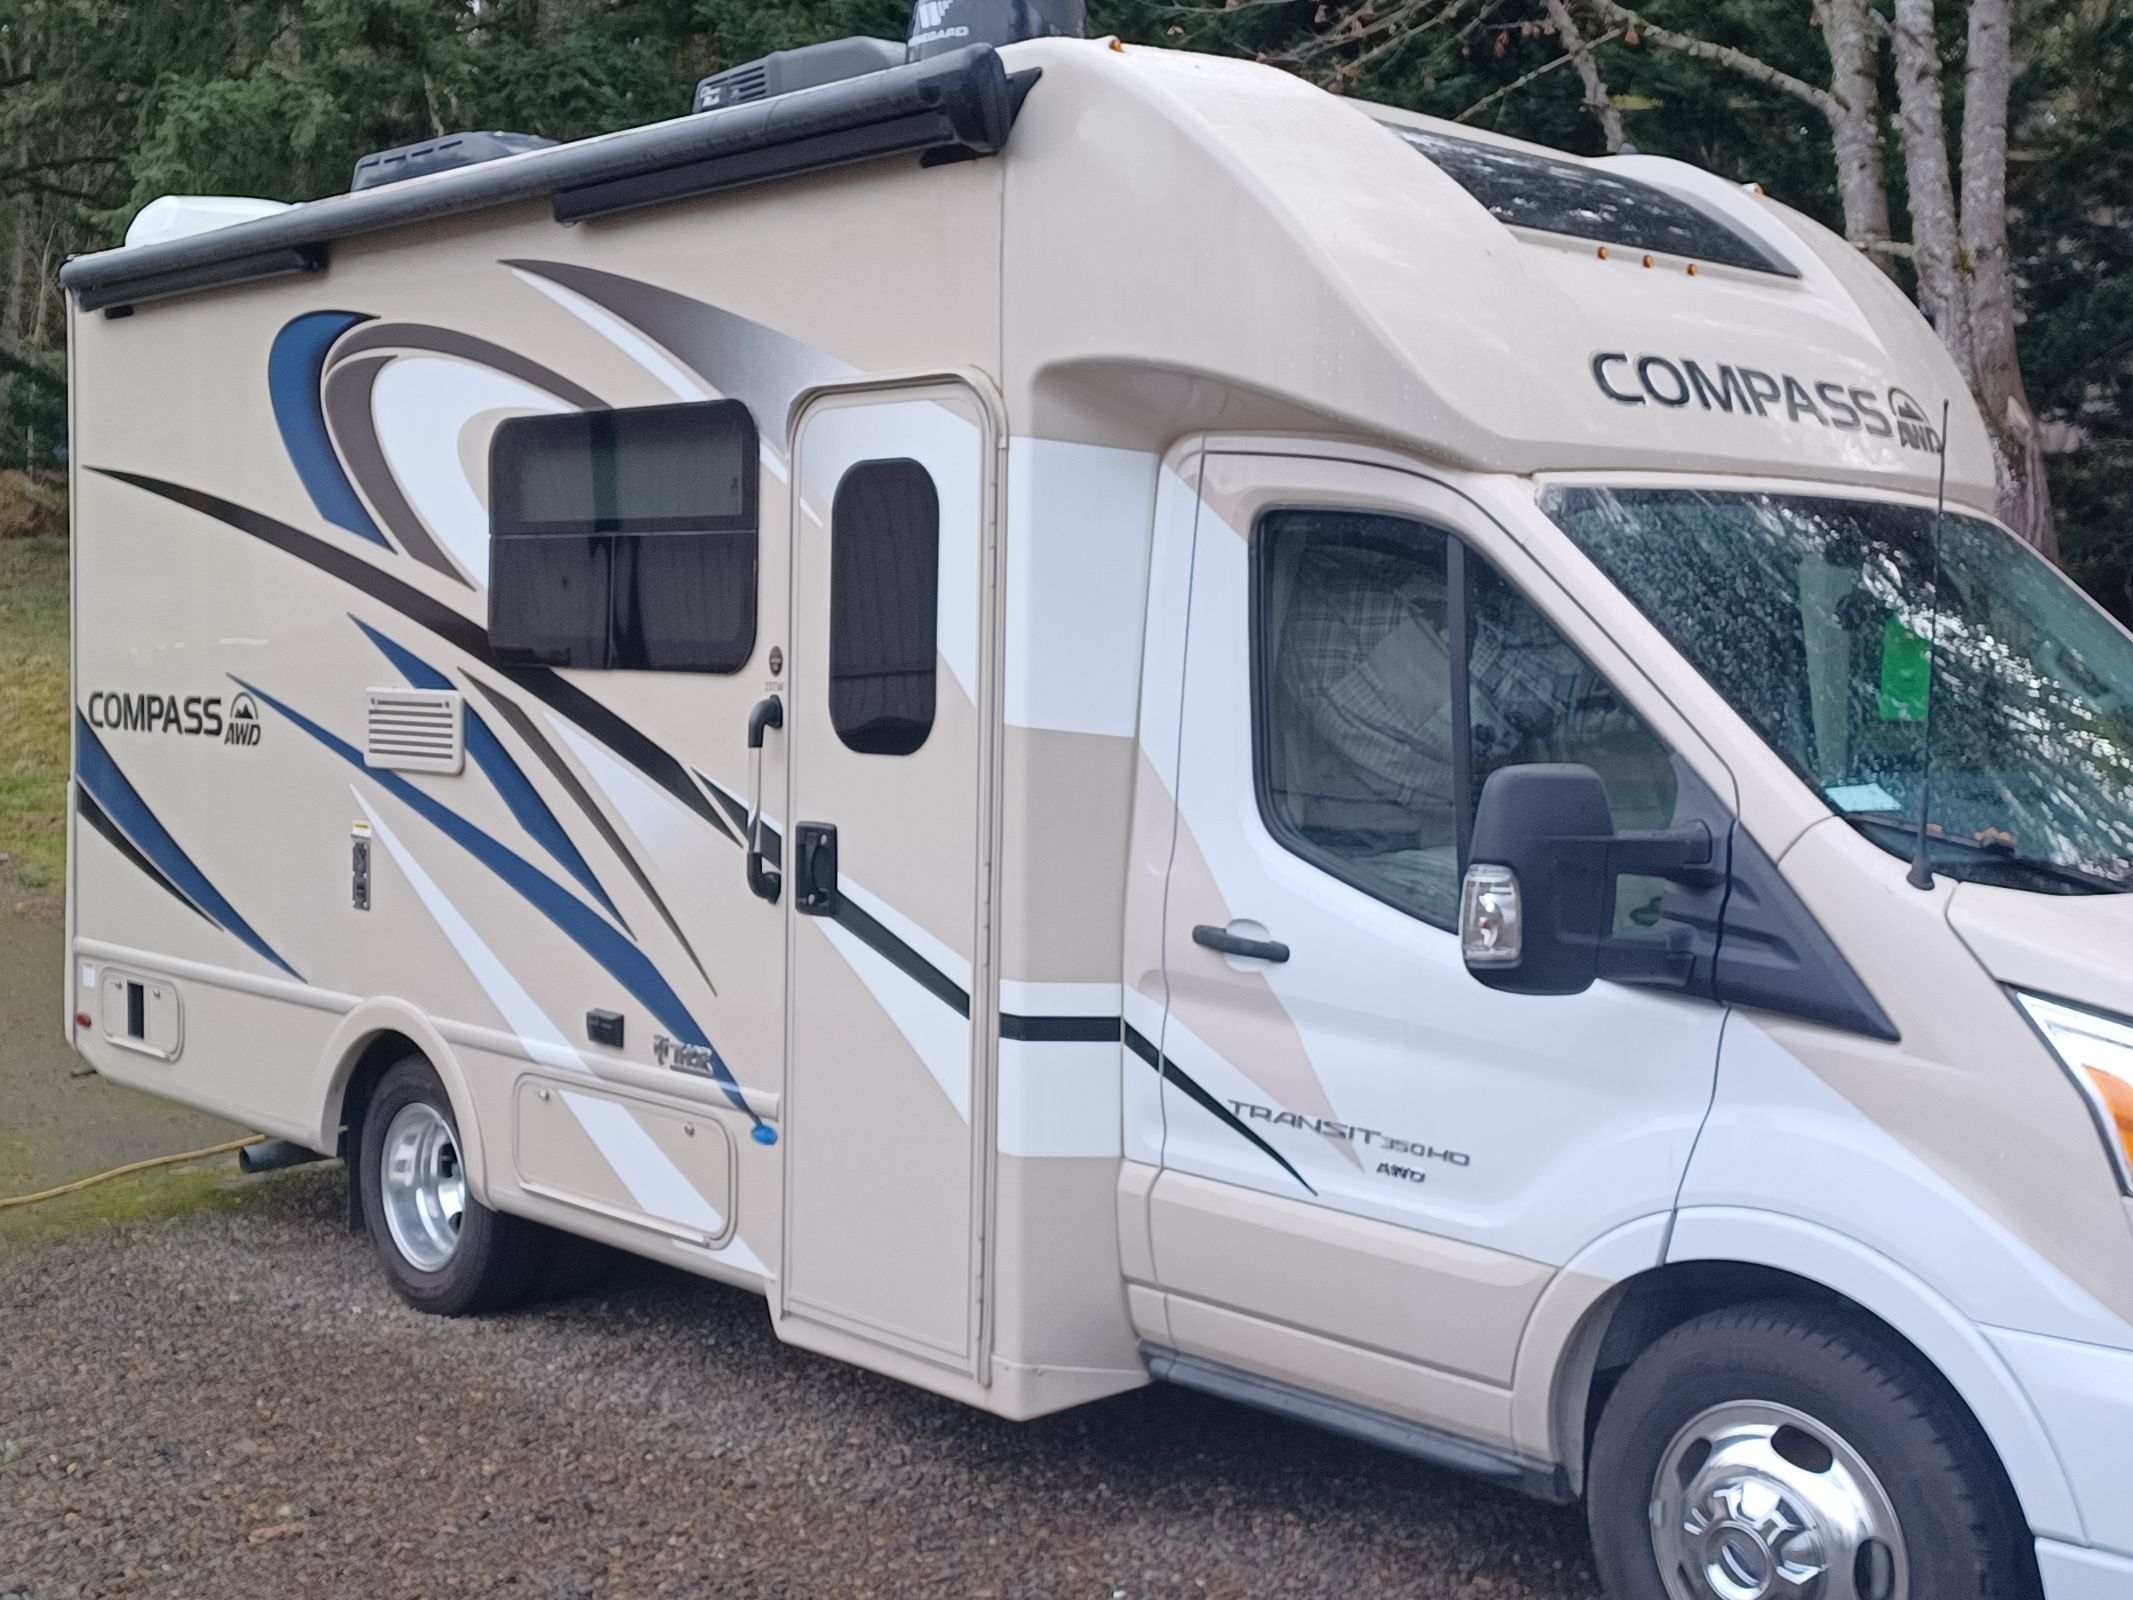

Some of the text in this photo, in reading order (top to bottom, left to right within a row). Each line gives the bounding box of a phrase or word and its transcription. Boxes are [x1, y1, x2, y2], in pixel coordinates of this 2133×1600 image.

[1591, 351, 1895, 440] COMPASS
[1896, 419, 1943, 454] AWD
[88, 690, 223, 737] COMPASS
[224, 722, 261, 746] AWD
[1227, 1099, 1381, 1146] TRANSIT
[1376, 1162, 1425, 1183] AWD
